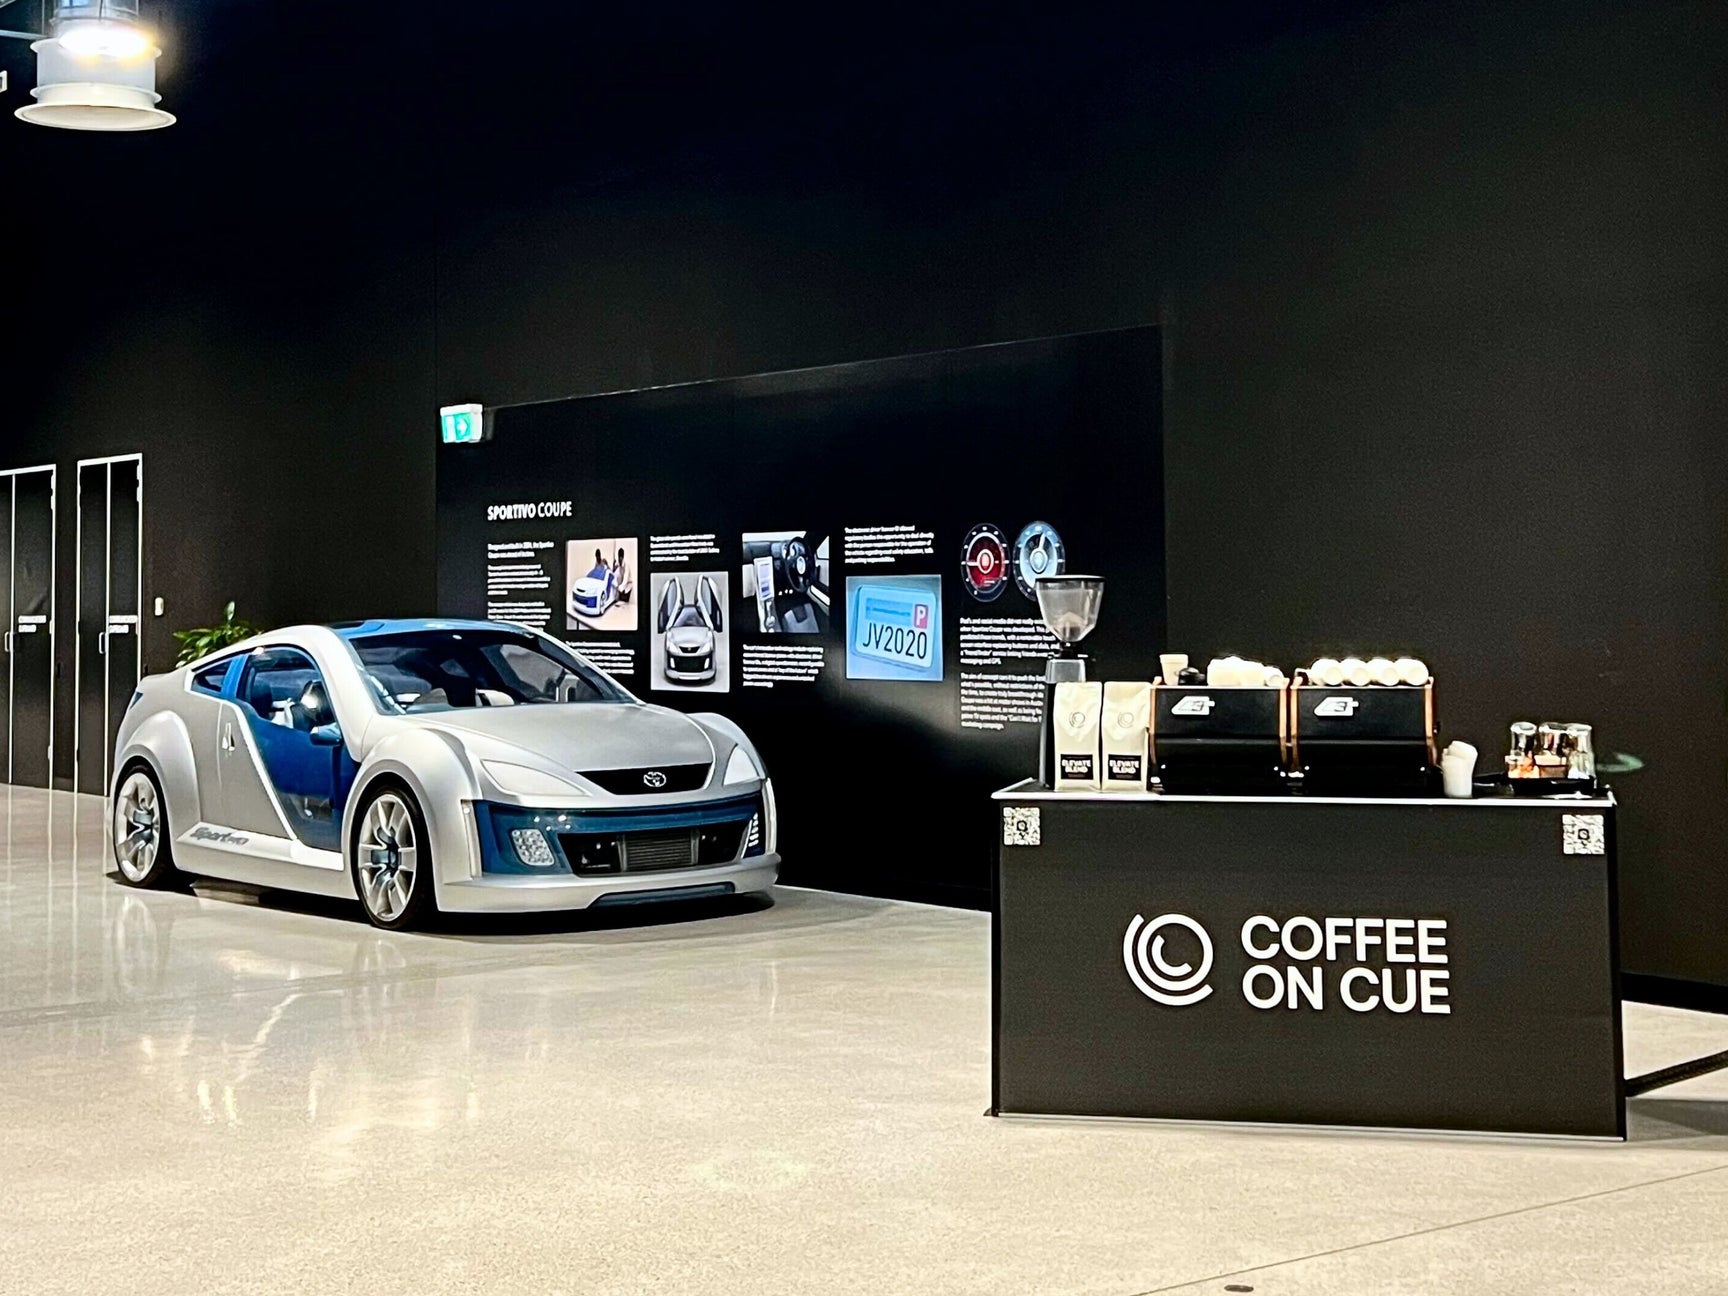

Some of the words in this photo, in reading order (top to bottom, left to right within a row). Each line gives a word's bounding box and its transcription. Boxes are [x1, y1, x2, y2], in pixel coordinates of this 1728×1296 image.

[487, 504, 537, 521] SPORTIVO
[538, 501, 573, 518] COUPE
[863, 622, 928, 660] JV2020
[1241, 914, 1449, 964] COFFEE
[1242, 964, 1324, 1011] ON
[1339, 966, 1451, 1014] CUE
